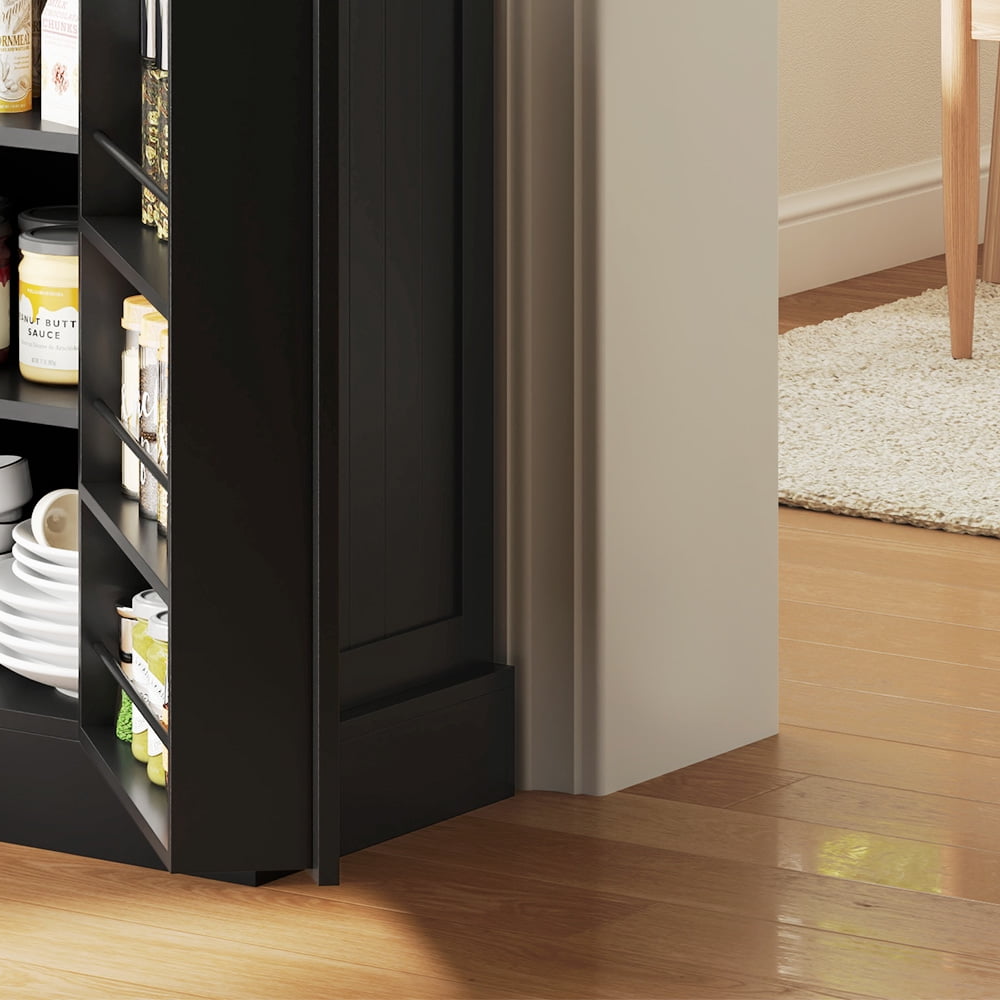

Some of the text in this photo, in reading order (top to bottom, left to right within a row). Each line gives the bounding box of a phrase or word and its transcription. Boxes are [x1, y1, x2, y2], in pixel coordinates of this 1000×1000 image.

[43, 18, 78, 34] CHUNKS
[45, 319, 77, 328] BUTT
[28, 328, 61, 340] SAUCE
